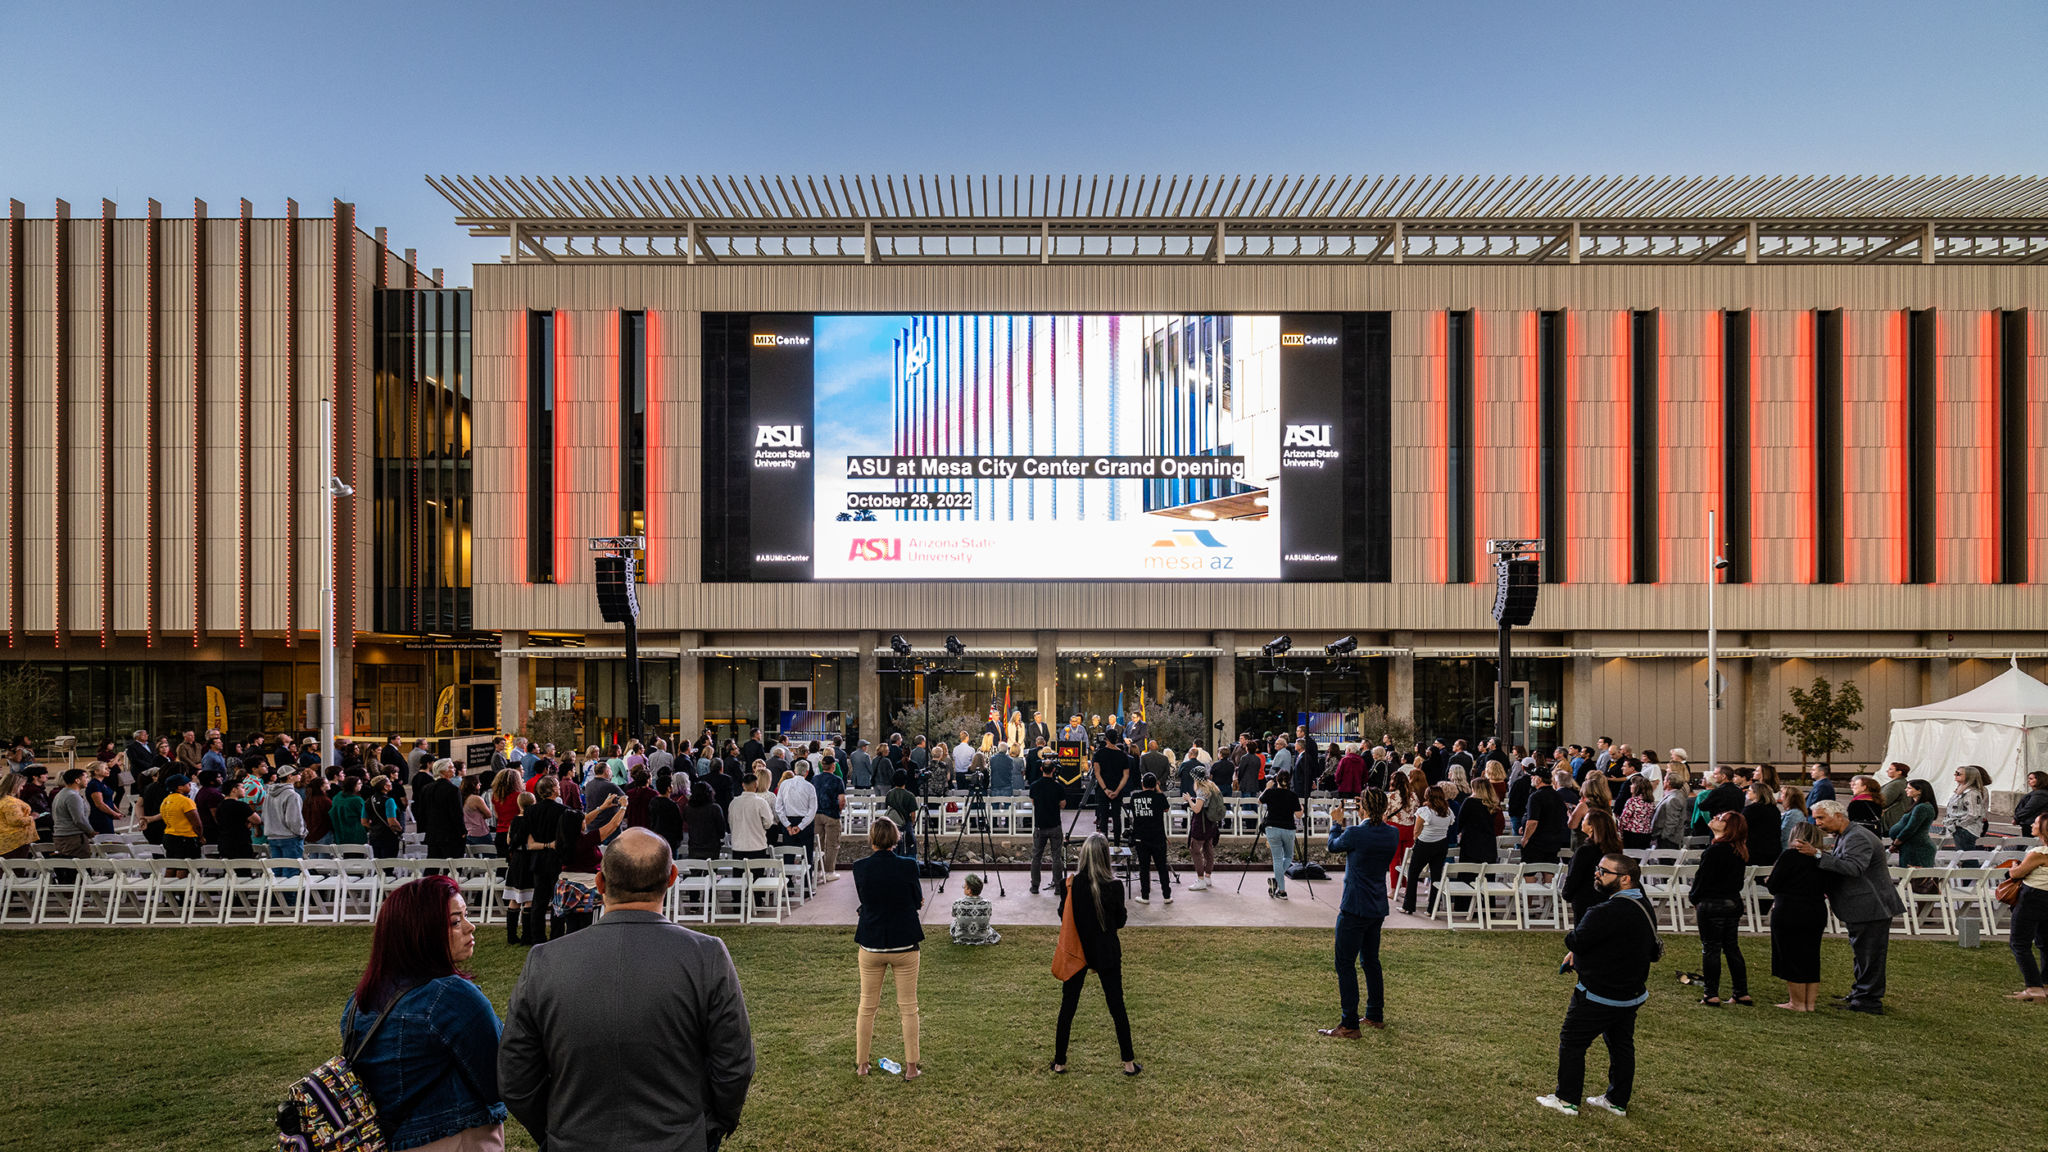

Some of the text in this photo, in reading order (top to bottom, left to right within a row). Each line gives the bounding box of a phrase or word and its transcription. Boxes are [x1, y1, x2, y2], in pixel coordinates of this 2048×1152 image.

[755, 425, 803, 447] ASU
[1283, 424, 1332, 447] ASU
[755, 450, 811, 459] Arizona State
[1283, 449, 1340, 458] Arizona State
[755, 459, 796, 469] University
[847, 458, 1245, 480] ASU at Mesa City Center Grand Opening
[1283, 458, 1325, 469] University
[847, 493, 972, 509] October 28, 2022
[848, 538, 901, 561] ASU
[908, 538, 959, 548] Arizona
[756, 554, 810, 562] #ASUMixCenter
[908, 551, 973, 563] University
[1144, 556, 1234, 570] mesa az
[1284, 553, 1338, 561] #ASUMixCenter
